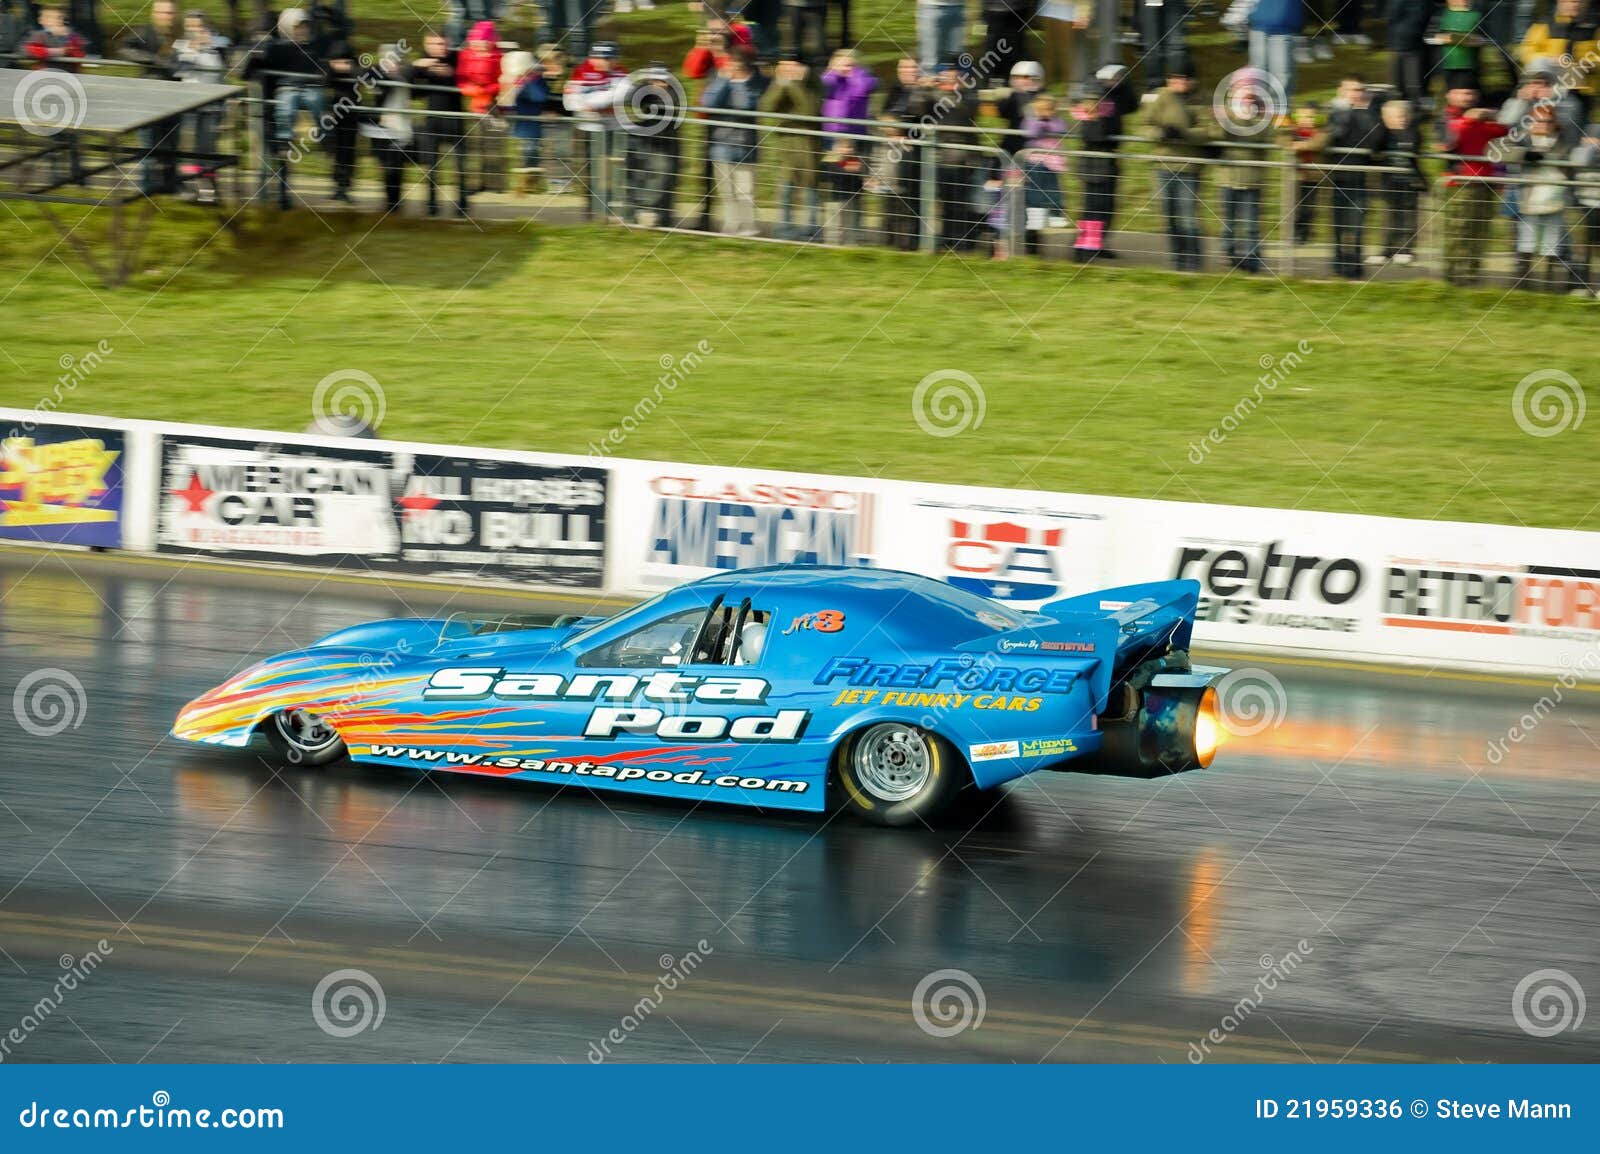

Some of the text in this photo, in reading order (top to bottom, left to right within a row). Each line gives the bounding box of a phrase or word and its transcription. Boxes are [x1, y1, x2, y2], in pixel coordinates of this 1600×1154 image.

[217, 495, 323, 528] CAR
[649, 476, 858, 510] CLASSIC
[480, 511, 604, 549] BULL
[1174, 540, 1366, 605] retro
[1194, 598, 1258, 624] ars
[422, 667, 772, 705] Santa
[830, 690, 1043, 712] JET FUNNY CARS
[582, 706, 813, 744] Pod
[370, 744, 810, 793] www.santapod.com
